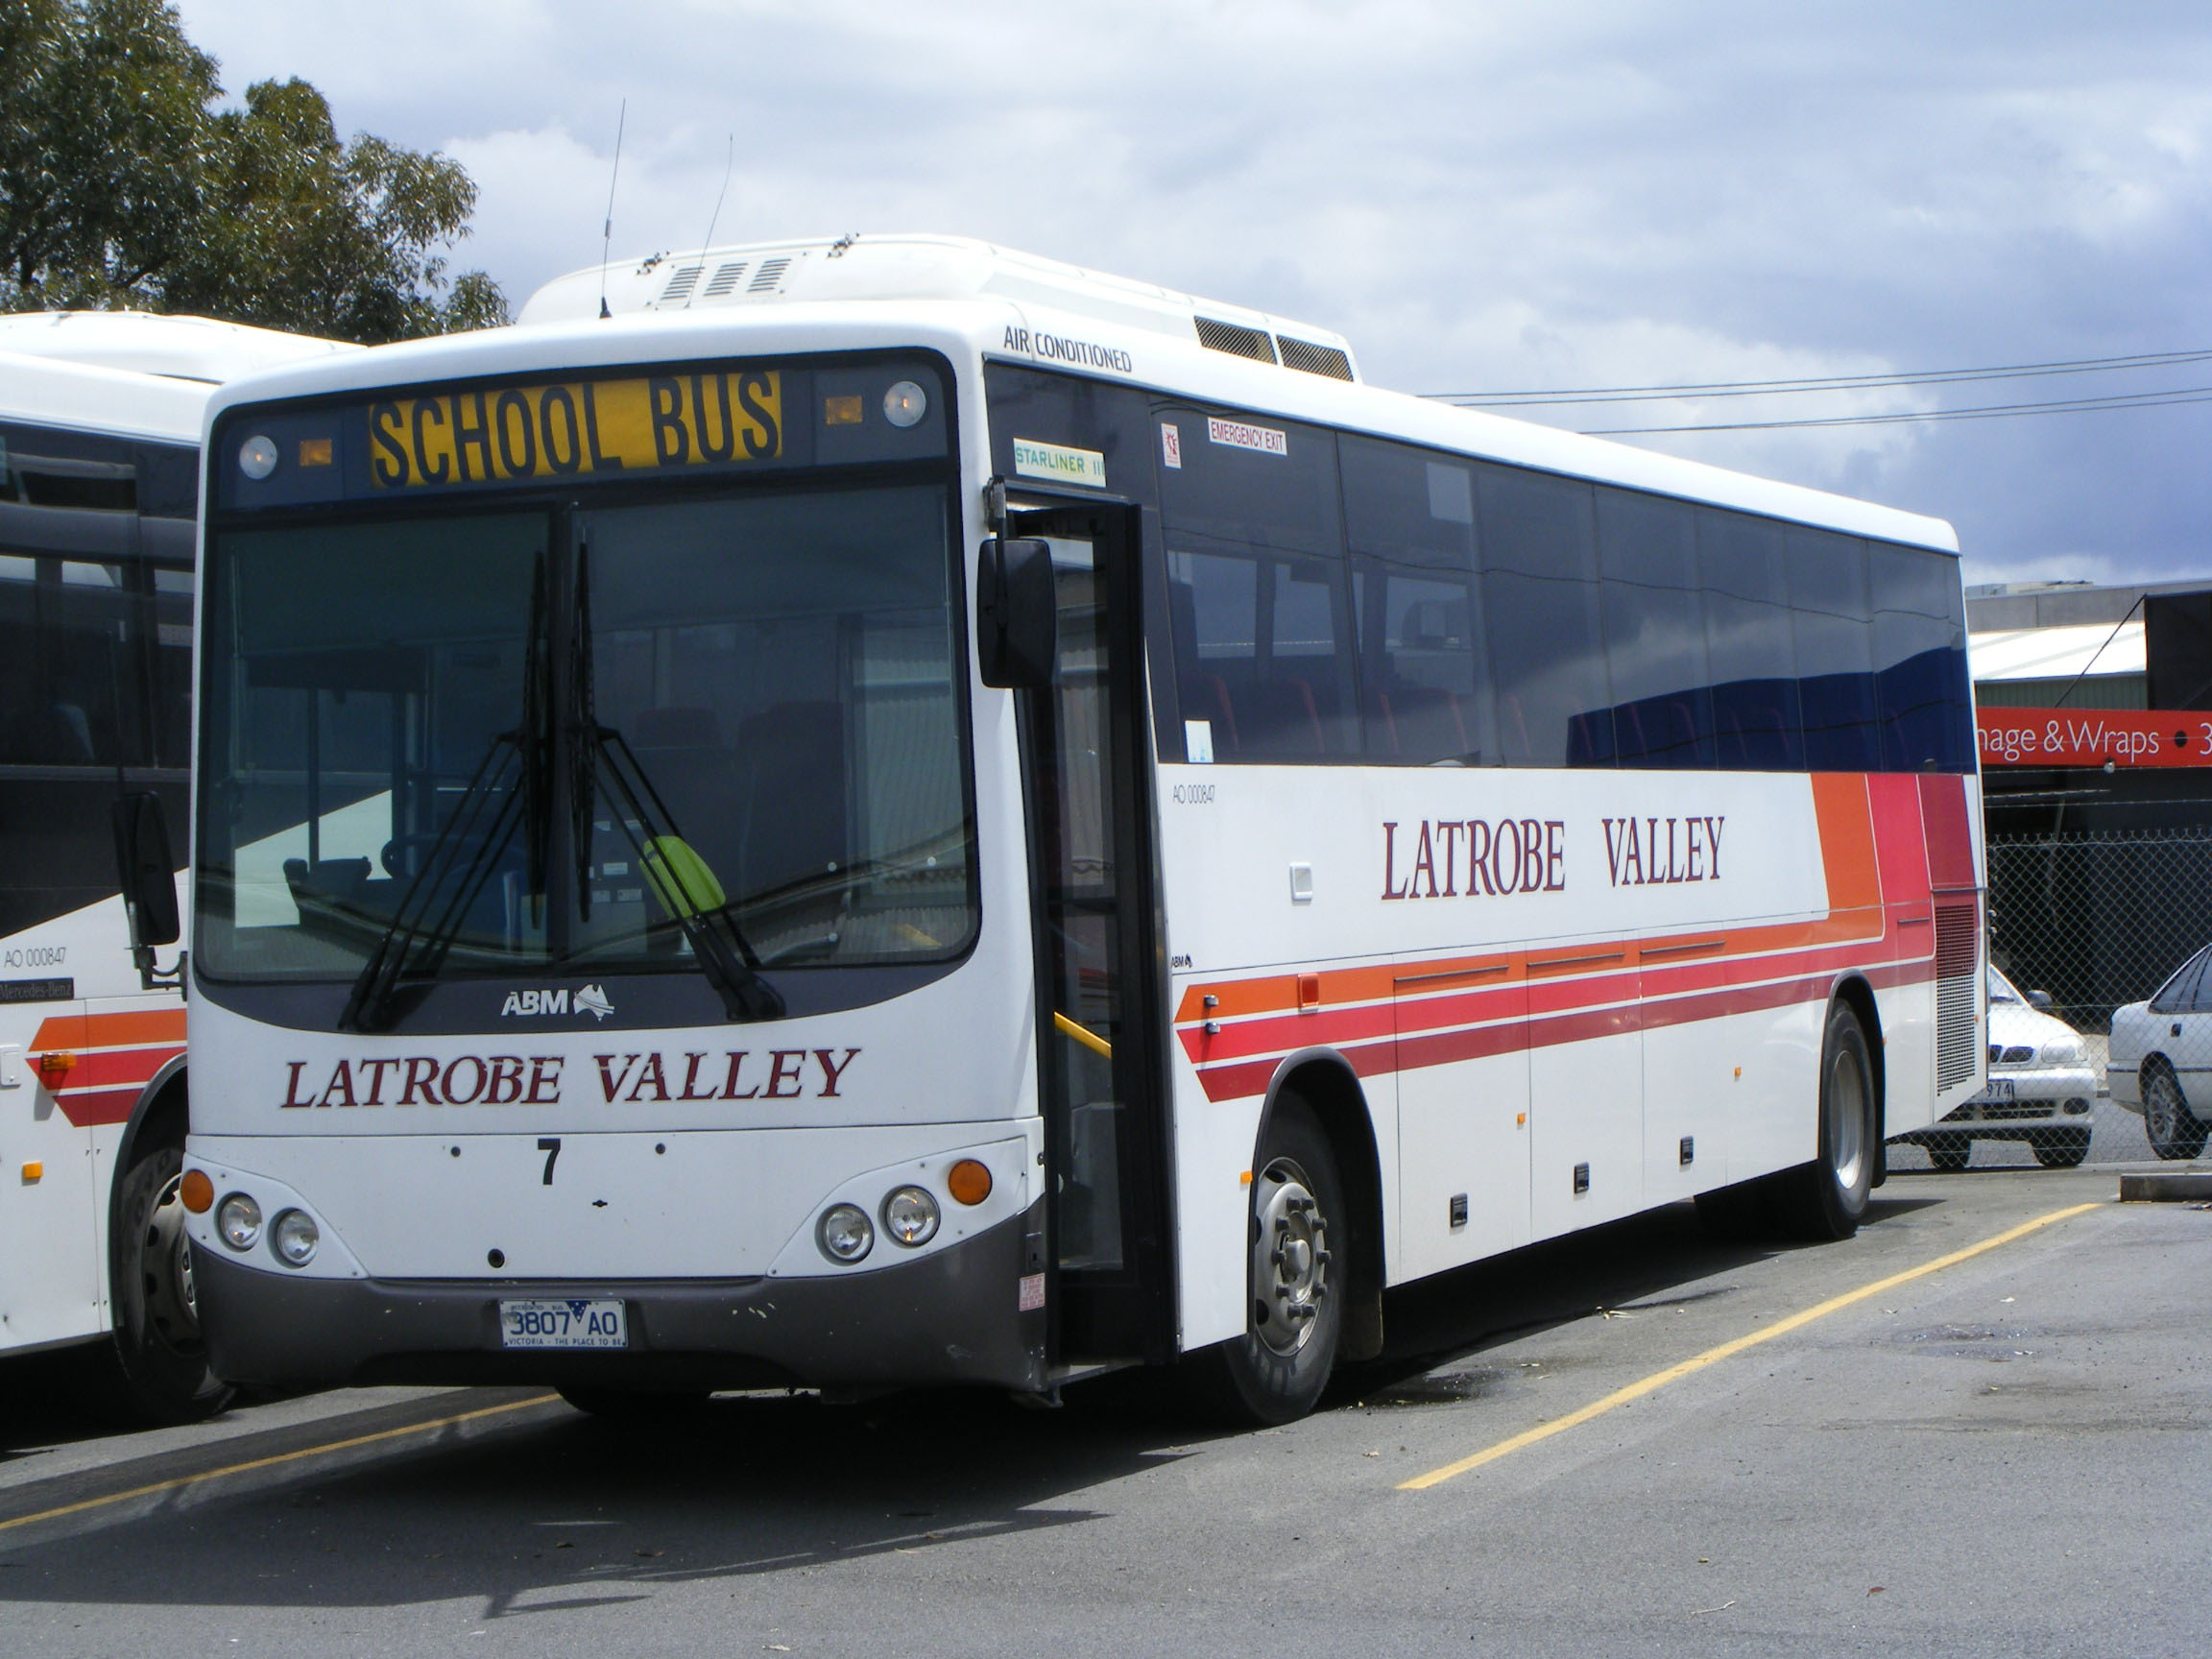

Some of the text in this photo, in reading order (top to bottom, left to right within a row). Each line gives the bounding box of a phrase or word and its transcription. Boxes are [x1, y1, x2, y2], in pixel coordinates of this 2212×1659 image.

[1003, 325, 1133, 373] AIR CONDITIONED
[371, 373, 780, 488] SCHOOL BUS
[1211, 421, 1284, 453] EMERGENCY EXIT
[1015, 446, 1085, 473] STARLINER
[2042, 720, 2064, 753] &
[2067, 720, 2160, 763] Wraps
[1381, 816, 1725, 901] LATROBE VALLEY
[26, 947, 67, 968] 000847
[501, 990, 568, 1016] ABM
[280, 1048, 862, 1109] LATROBE VALLEY
[538, 1138, 561, 1186] 7
[509, 1310, 571, 1335] 3807
